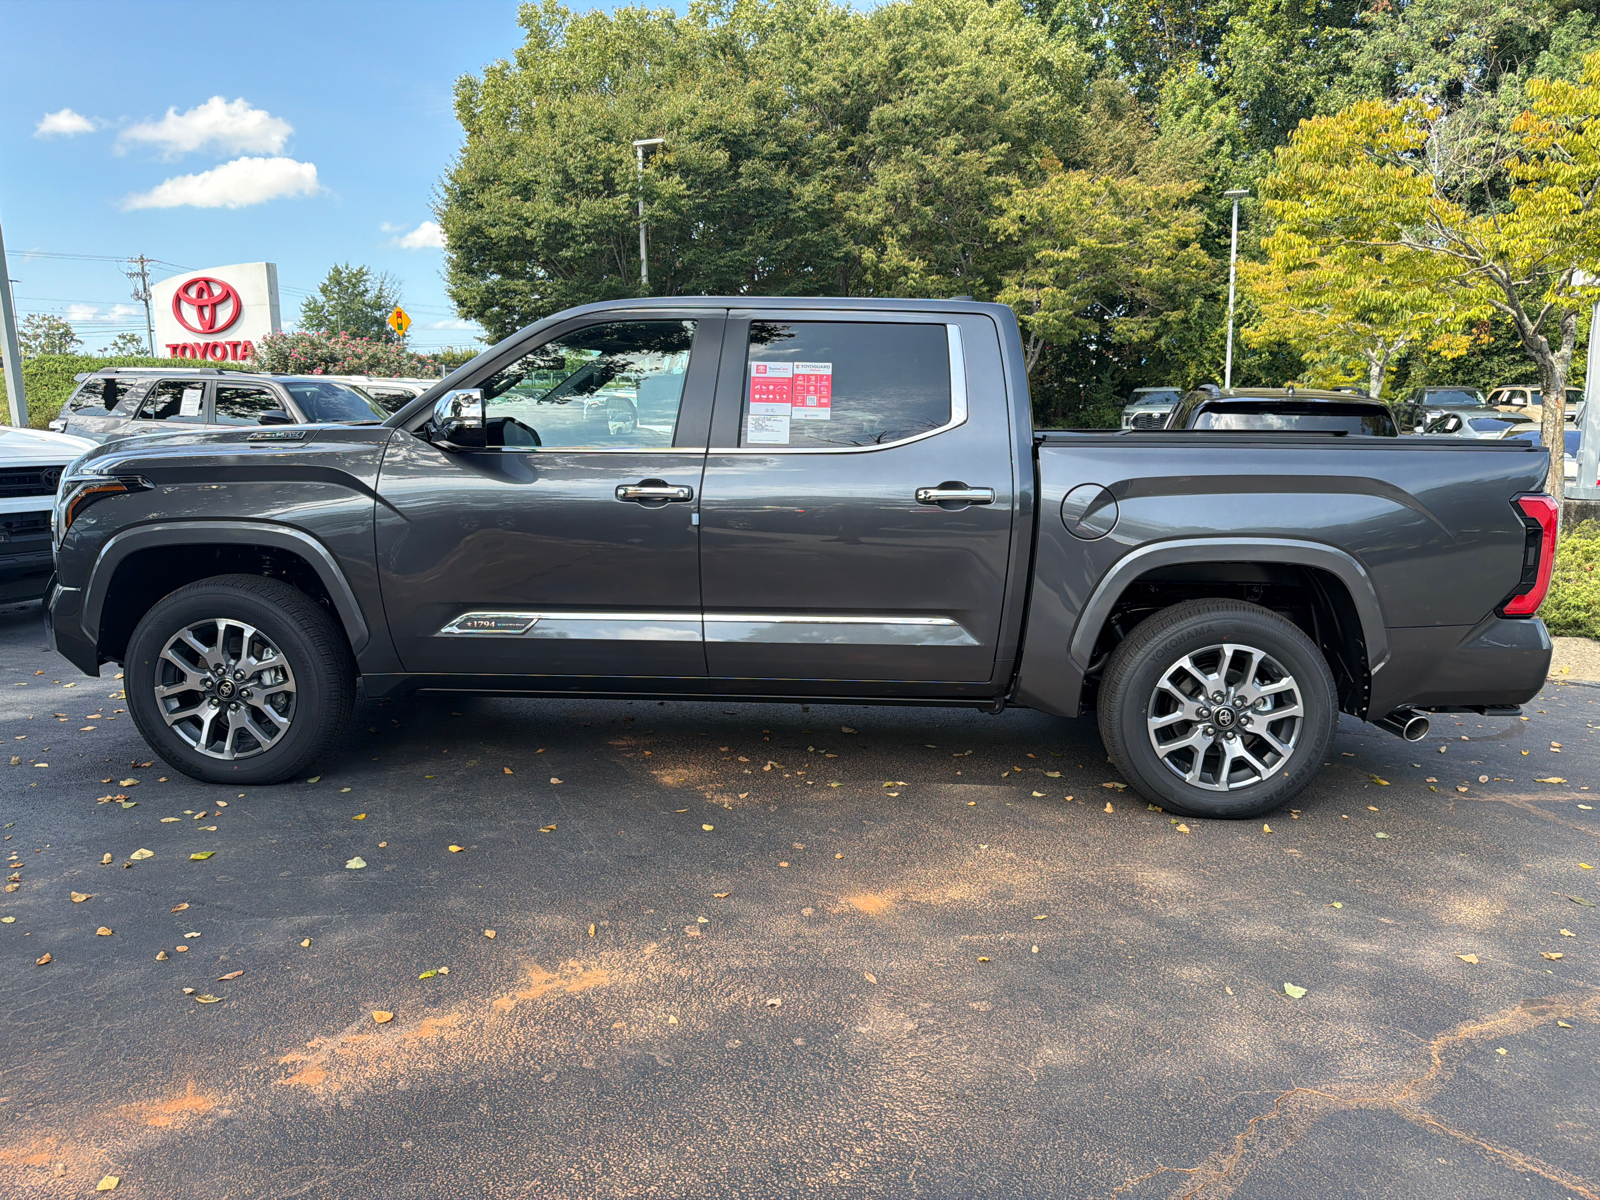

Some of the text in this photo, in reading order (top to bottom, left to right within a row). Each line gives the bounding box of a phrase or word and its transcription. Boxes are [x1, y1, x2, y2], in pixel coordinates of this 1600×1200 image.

[165, 340, 256, 361] TOYOTA
[473, 620, 495, 628] 1794
[1149, 624, 1215, 663] YOKOHAMA
[1262, 712, 1328, 803] GEOLANDAR
